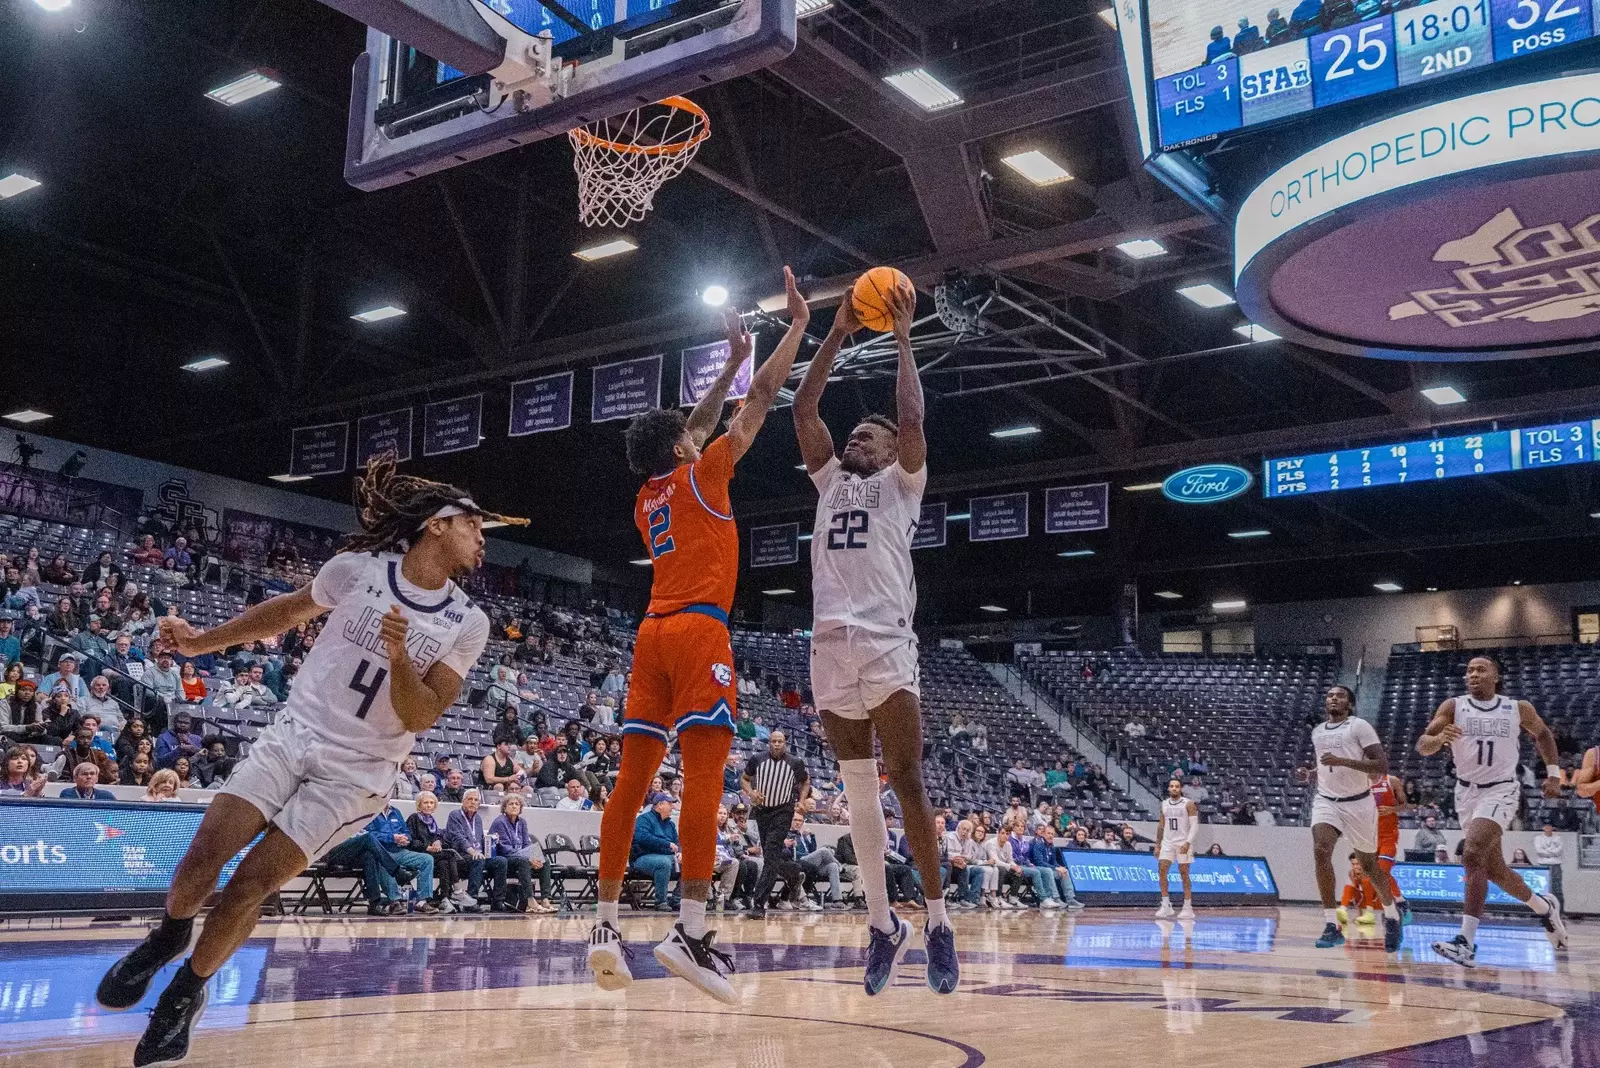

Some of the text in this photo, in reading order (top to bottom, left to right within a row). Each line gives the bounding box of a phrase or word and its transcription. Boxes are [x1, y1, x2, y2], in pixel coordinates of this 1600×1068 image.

[1404, 0, 1487, 45] 18:01
[1323, 23, 1388, 82] 25
[1512, 27, 1567, 54] POSS
[1420, 46, 1472, 77] 2ND
[1173, 64, 1228, 92] TOL 3
[1175, 95, 1206, 116] FLS
[1222, 85, 1231, 101] 1
[1163, 133, 1218, 152] DAKTRONICS
[1270, 116, 1490, 218] ORTHOPEDIC
[1526, 429, 1564, 446] TOL
[1570, 426, 1583, 441] 3
[1276, 436, 1483, 470] PLY 4 7 10 11 22
[1277, 448, 1483, 482] FLS 2 2 1 3 0
[1528, 444, 1584, 465] FLS 1
[1181, 472, 1231, 496] Ford
[1277, 462, 1484, 494] PTS 2 5 7 0 0
[648, 503, 676, 560] 2
[826, 509, 869, 550] 22
[348, 658, 389, 720] 4
[1462, 717, 1511, 738] JACKS
[1476, 740, 1495, 767] 11
[1169, 818, 1178, 831] 10
[0, 840, 67, 865] orts
[1070, 865, 1089, 881] GET
[1088, 865, 1113, 881] FREE
[1110, 866, 1148, 881] TICKETS!
[1391, 868, 1447, 879] GET FREE
